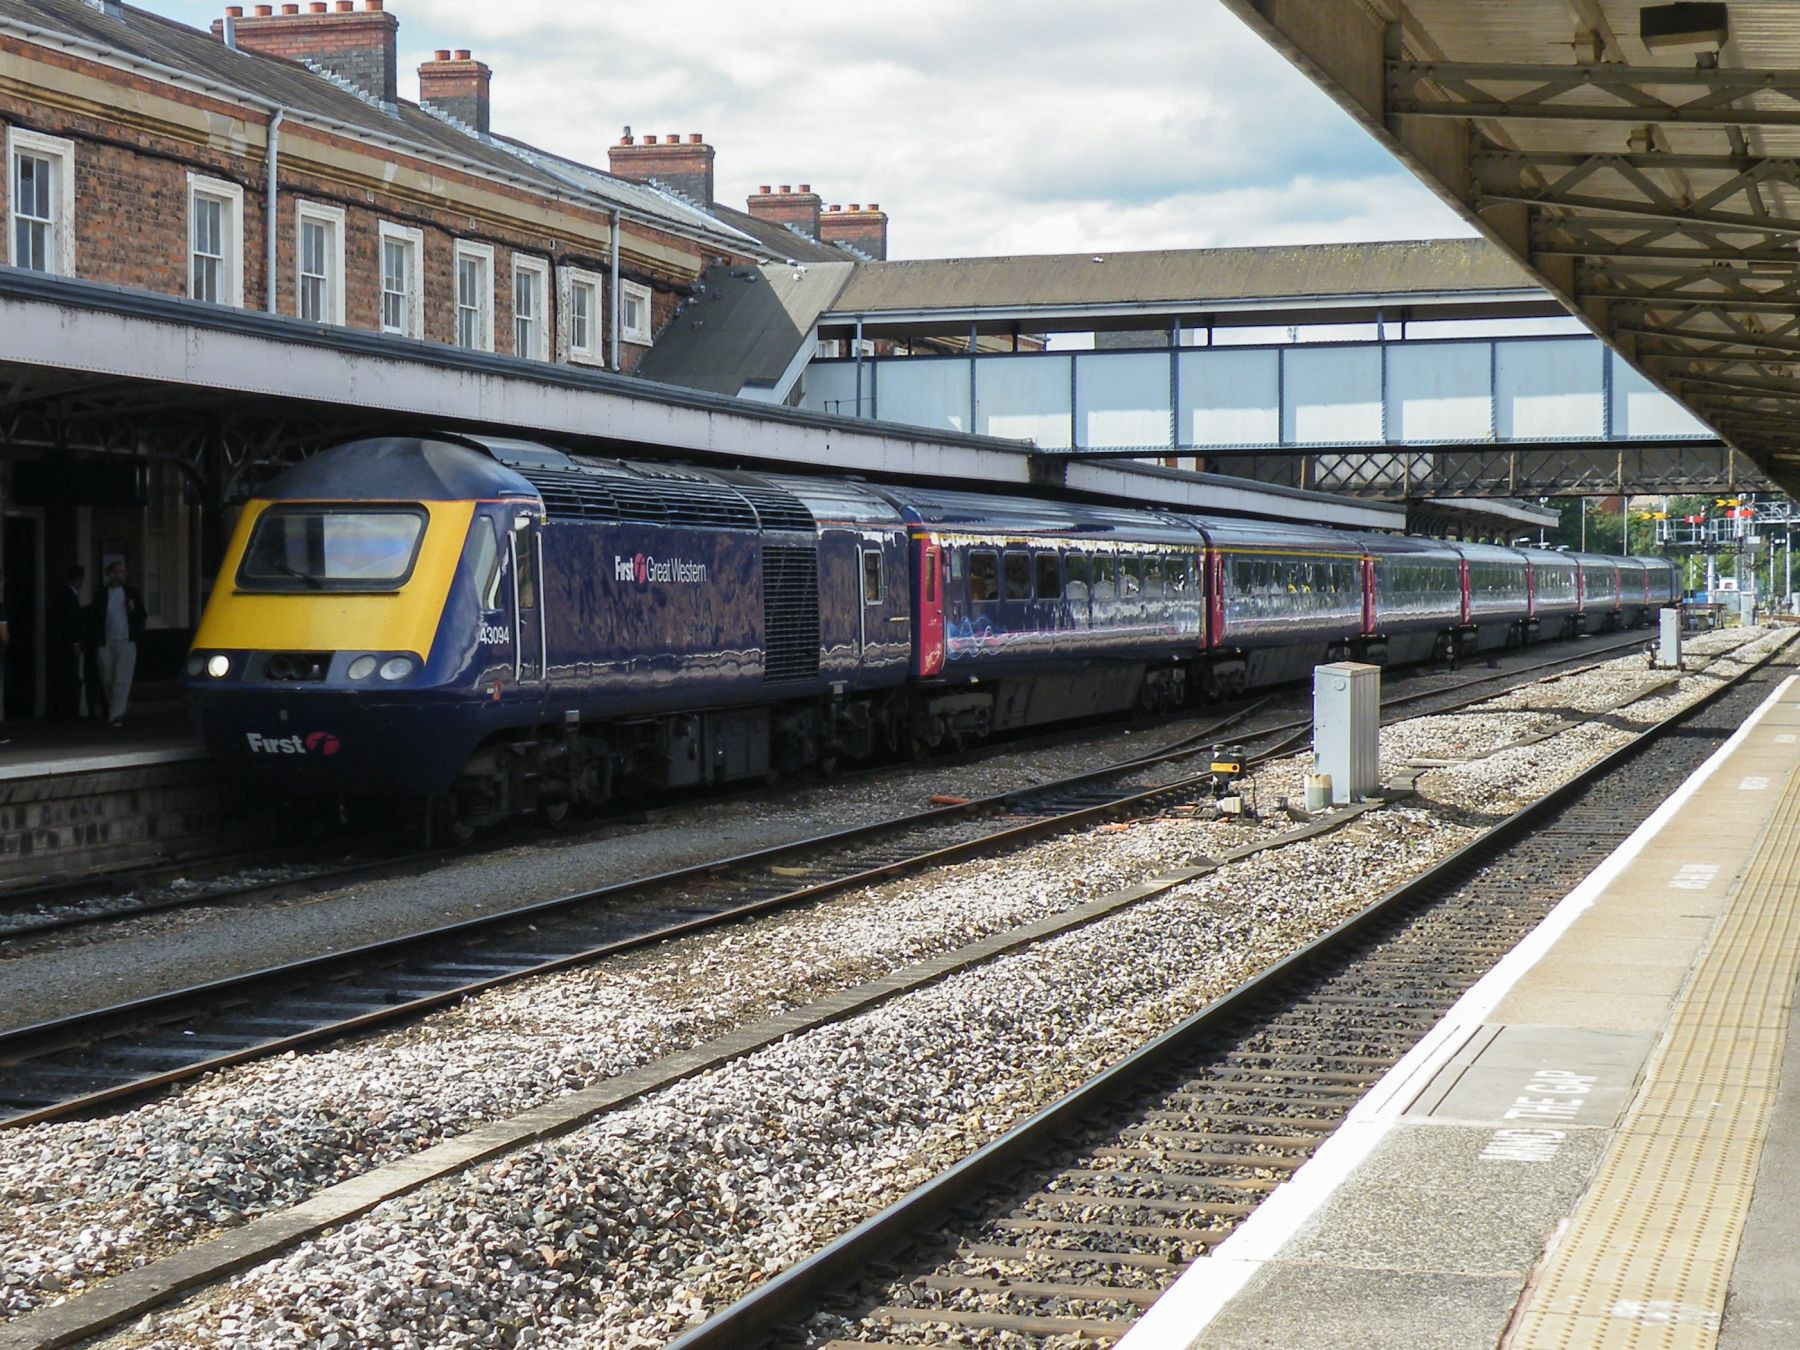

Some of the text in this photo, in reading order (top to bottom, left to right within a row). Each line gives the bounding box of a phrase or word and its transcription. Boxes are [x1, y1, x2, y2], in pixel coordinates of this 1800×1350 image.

[615, 555, 707, 583] First Great Western
[480, 626, 510, 645] 43094
[246, 732, 306, 754] First
[1478, 1069, 1598, 1161] MIND THE GAP
